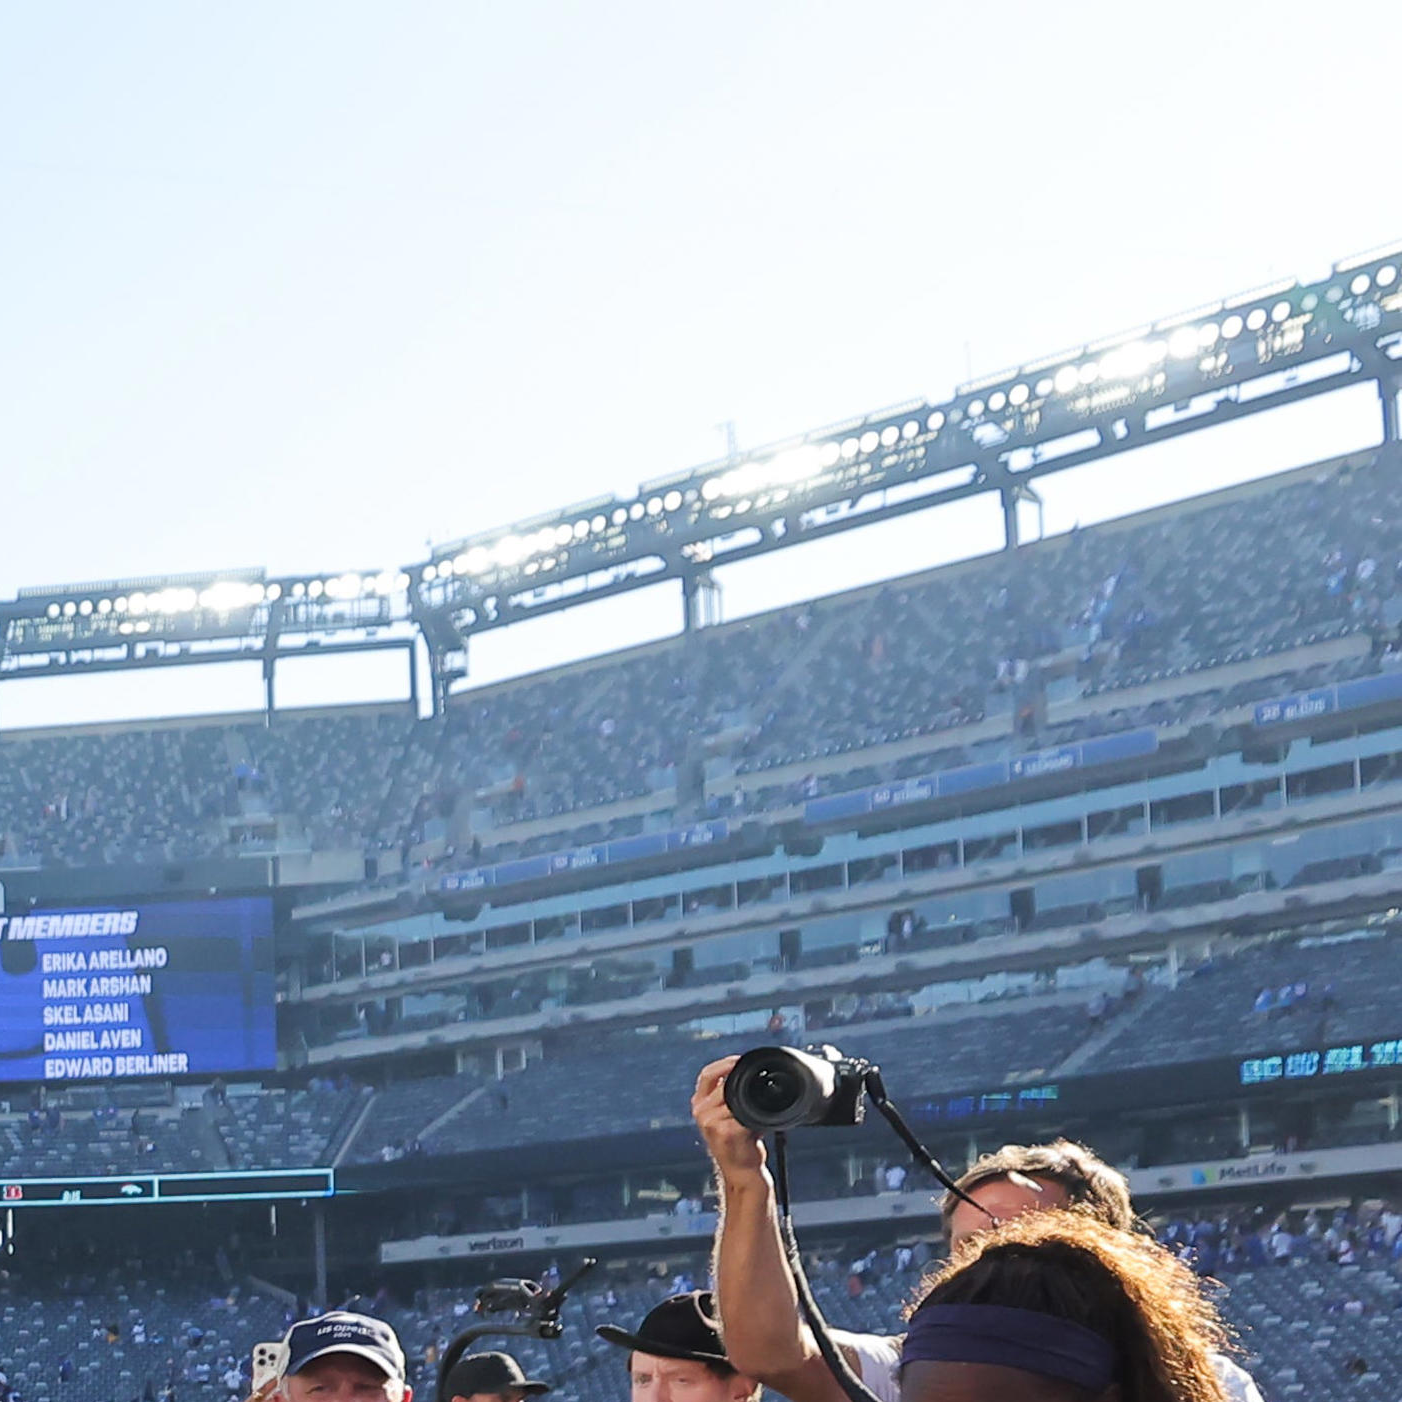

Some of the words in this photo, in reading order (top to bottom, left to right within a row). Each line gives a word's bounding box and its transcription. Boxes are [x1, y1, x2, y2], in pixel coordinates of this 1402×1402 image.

[7, 911, 138, 940] MEMBERS
[42, 952, 87, 973] ERIKA
[89, 948, 168, 970] ARELLANO
[43, 979, 87, 999] MARK
[89, 974, 152, 996] ARSHAN
[43, 1005, 82, 1025] SKEL
[83, 1003, 129, 1024] ASANI
[44, 1031, 99, 1052] DANIEL
[100, 1028, 142, 1049] AVEN
[45, 1057, 113, 1079] EDWARD
[115, 1053, 188, 1075] BERLINER
[1220, 1162, 1287, 1181] MetLife
[468, 1236, 523, 1251] verizon
